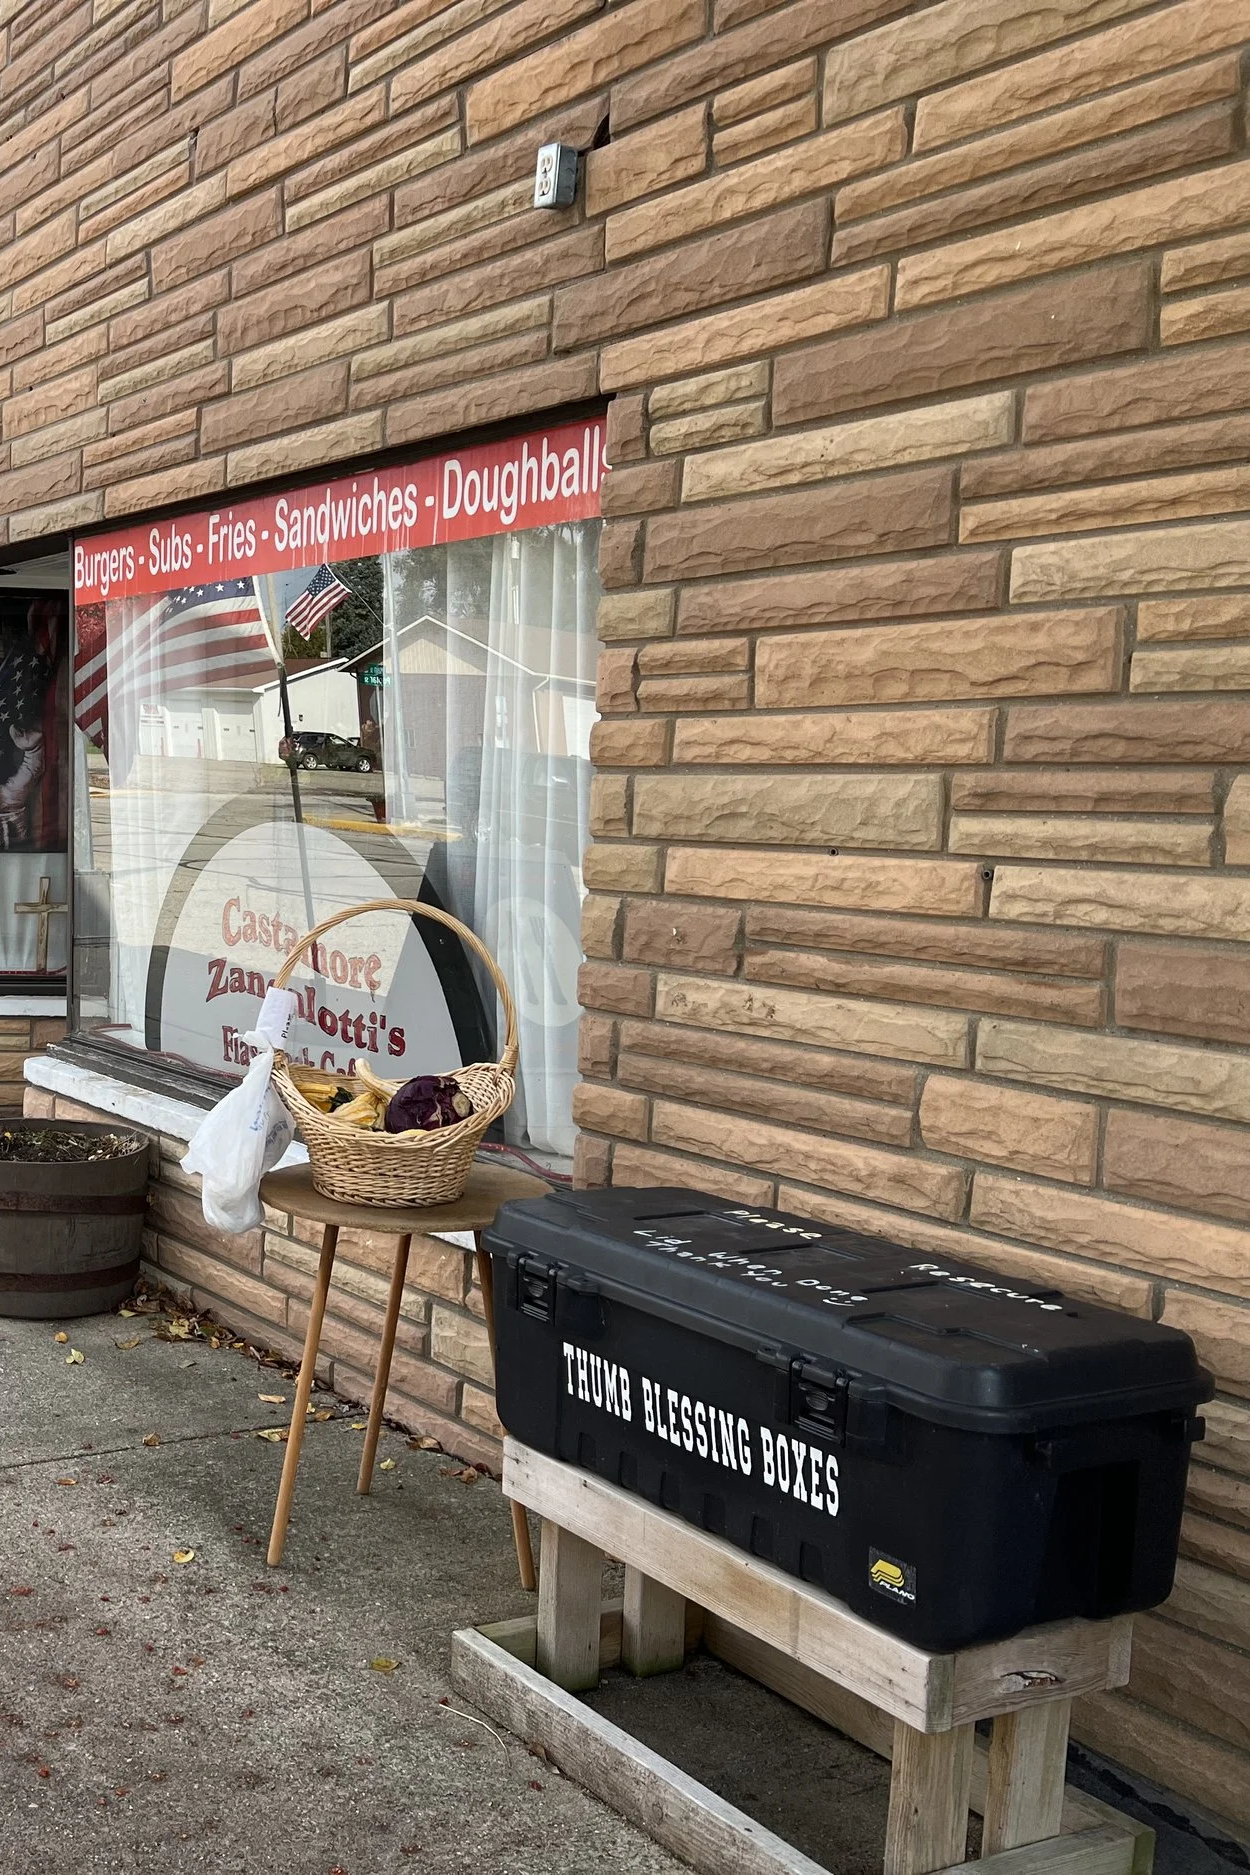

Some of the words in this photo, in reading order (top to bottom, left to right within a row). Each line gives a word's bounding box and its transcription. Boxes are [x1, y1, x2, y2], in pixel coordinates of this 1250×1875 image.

[73, 544, 136, 597] Burgers
[148, 524, 193, 576] Subs
[208, 514, 257, 565] Fries
[274, 475, 419, 553] Sandwiches
[205, 956, 407, 1057] Zanlotti's
[633, 1229, 693, 1245] Lid
[707, 1251, 783, 1275] When
[795, 1279, 869, 1301] Done
[645, 1240, 733, 1268] Thank
[740, 1270, 789, 1287] You
[722, 1209, 823, 1240] Please
[562, 1341, 632, 1422] THUMB
[641, 1376, 752, 1476] BLESSING
[760, 1425, 840, 1518] BOXES
